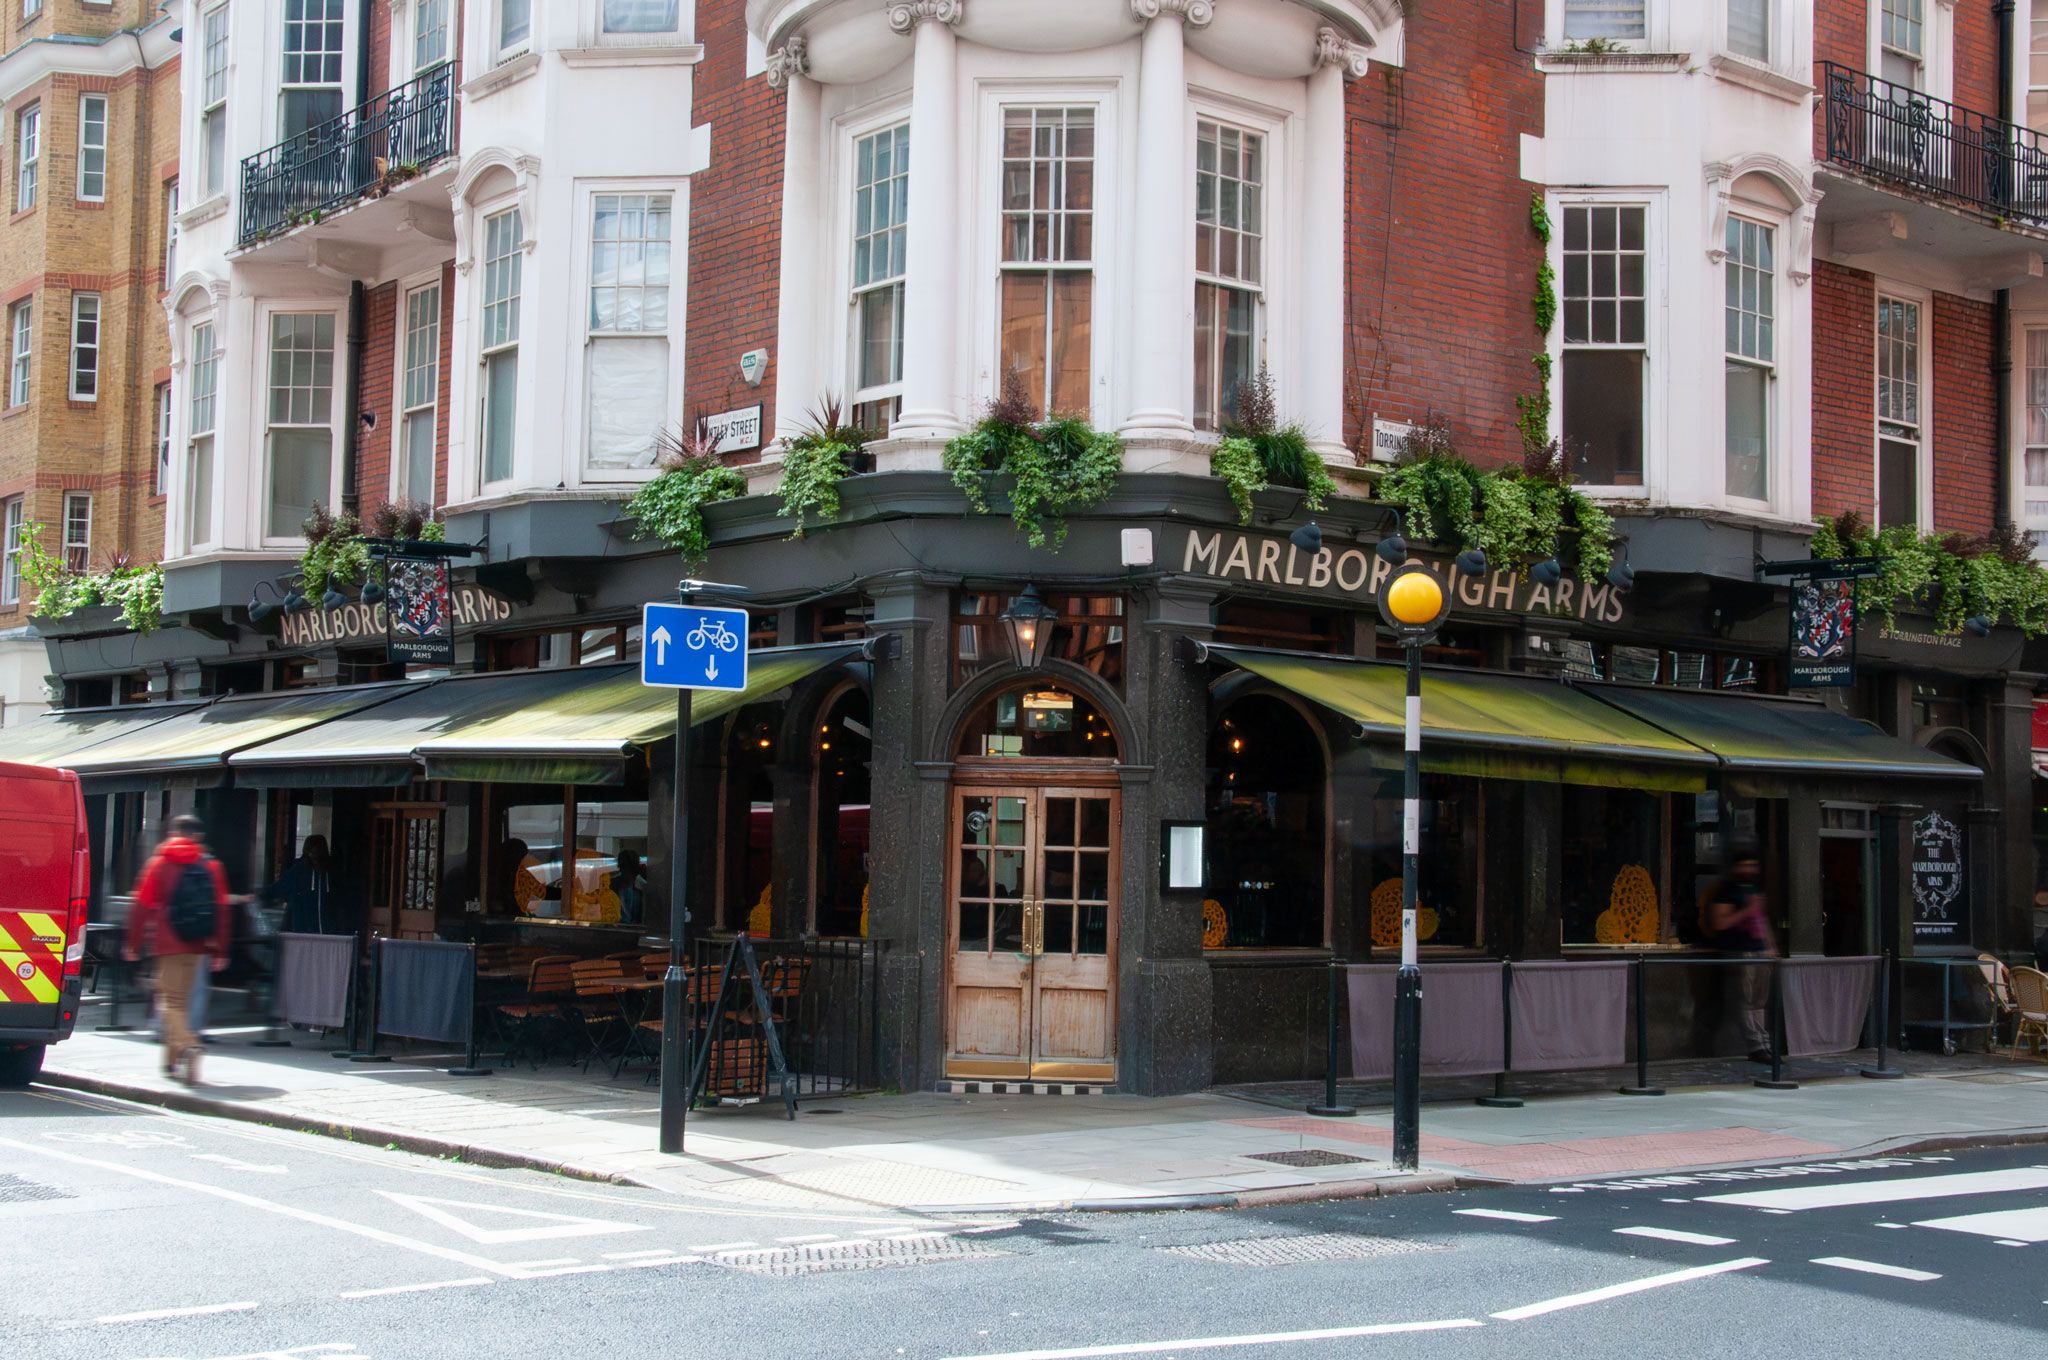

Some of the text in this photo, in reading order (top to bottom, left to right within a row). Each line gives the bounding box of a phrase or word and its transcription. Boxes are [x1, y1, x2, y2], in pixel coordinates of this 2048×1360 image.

[708, 423, 729, 442] NTLEY
[730, 418, 758, 437] STREET
[1375, 429, 1409, 451] TORRING
[1183, 530, 1623, 623] MARLBORGH ARMS
[280, 589, 511, 645] MARLBORO ARMS
[1939, 635, 1962, 648] PLACE
[394, 643, 449, 652] MARLBOROUGH
[1794, 666, 1850, 675] MARLBOROUGH
[1927, 848, 1940, 858] THE
[1912, 862, 1957, 872] MARLBOROUGH
[1927, 876, 1944, 886] ARMS
